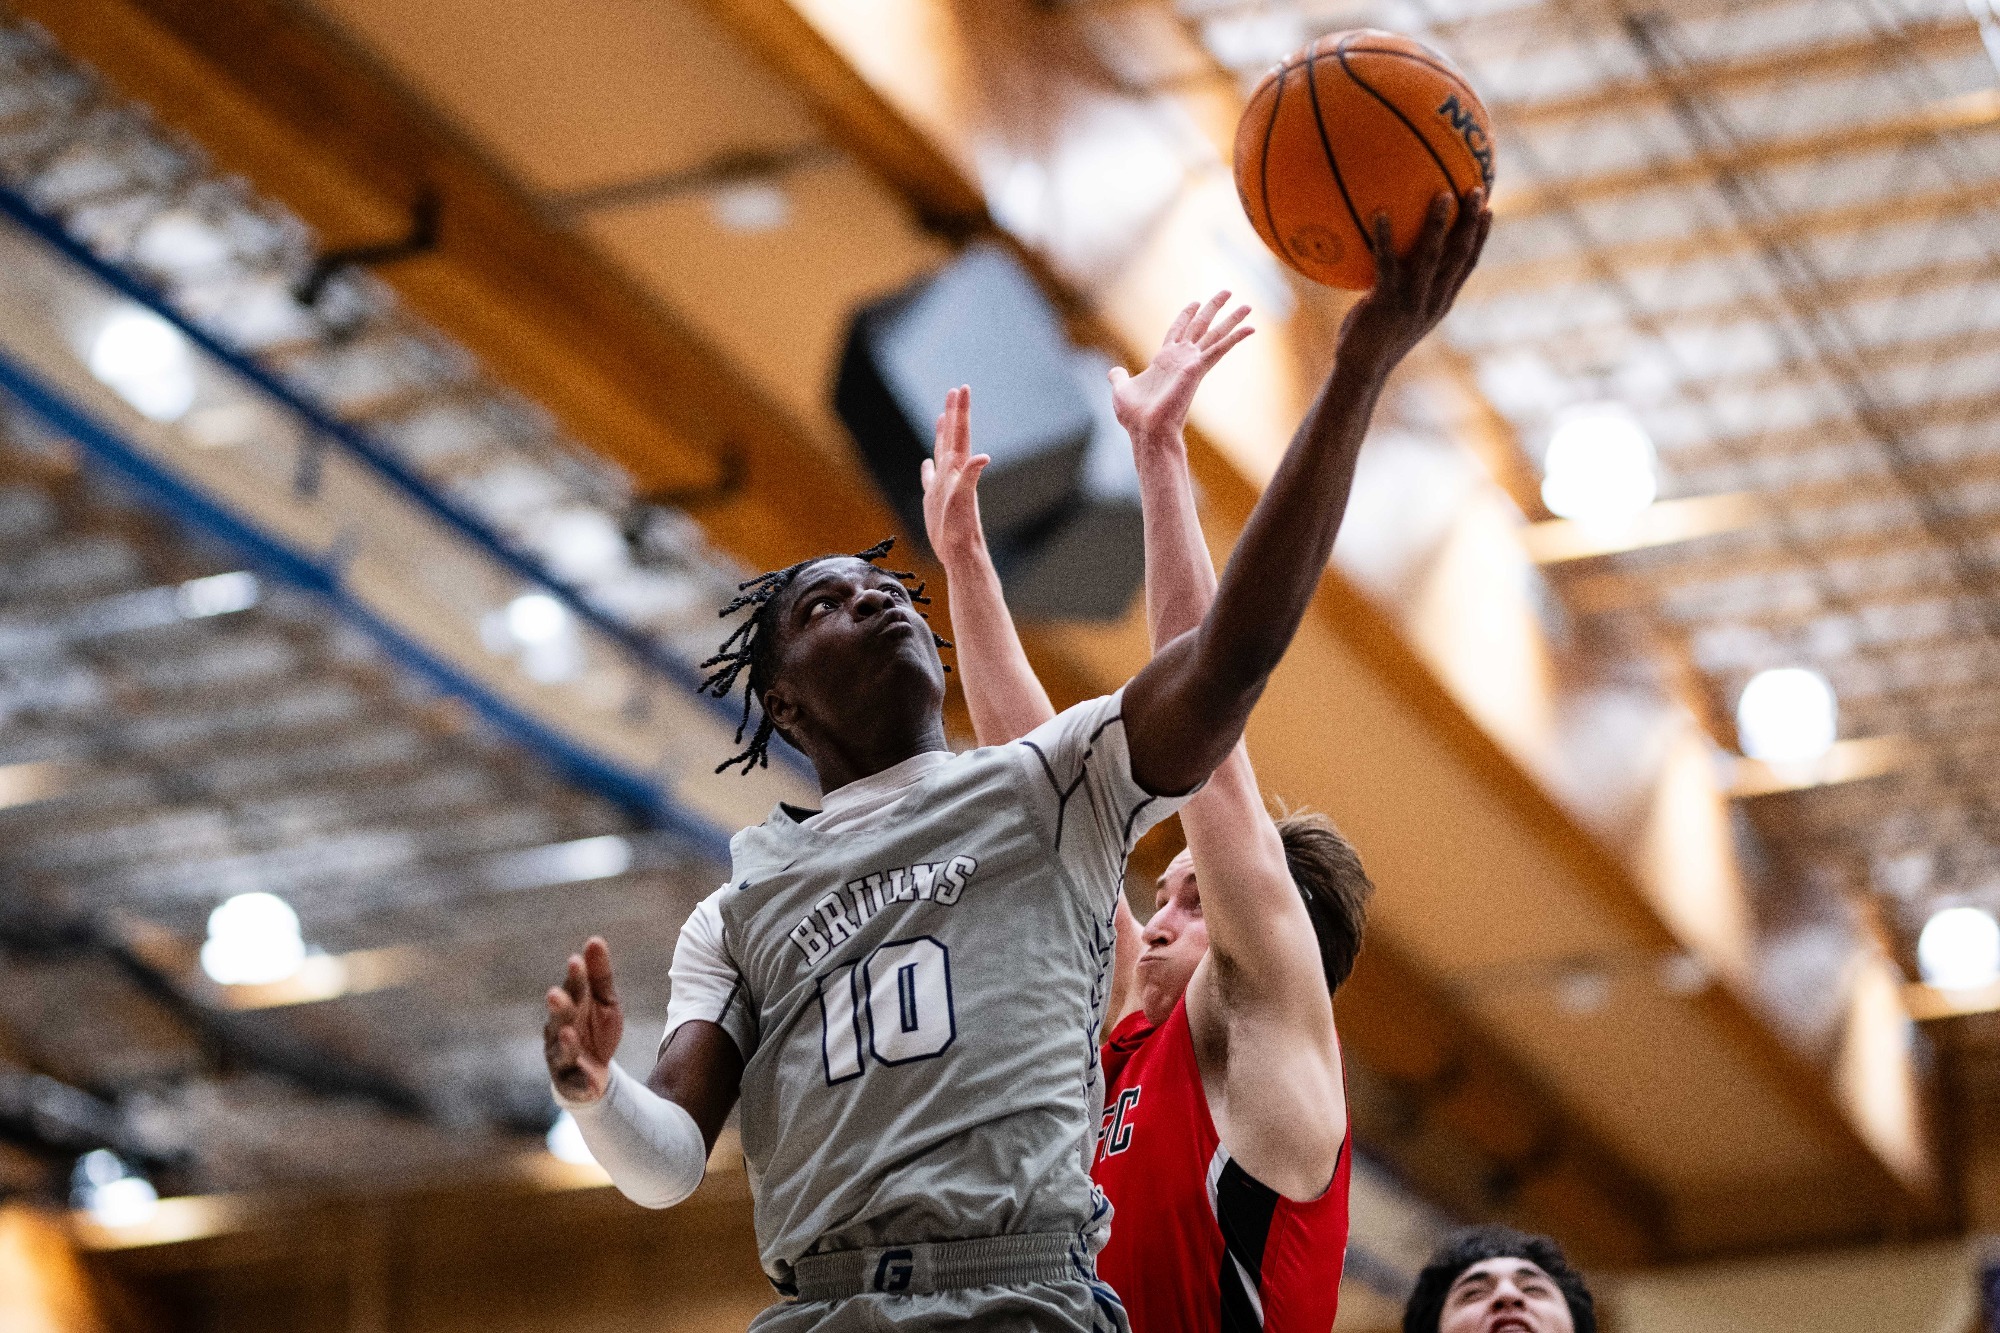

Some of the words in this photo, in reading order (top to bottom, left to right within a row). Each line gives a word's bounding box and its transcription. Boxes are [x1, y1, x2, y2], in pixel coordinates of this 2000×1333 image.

[789, 855, 977, 966] BRUINS
[816, 935, 957, 1087] 10
[874, 1250, 913, 1295] G
